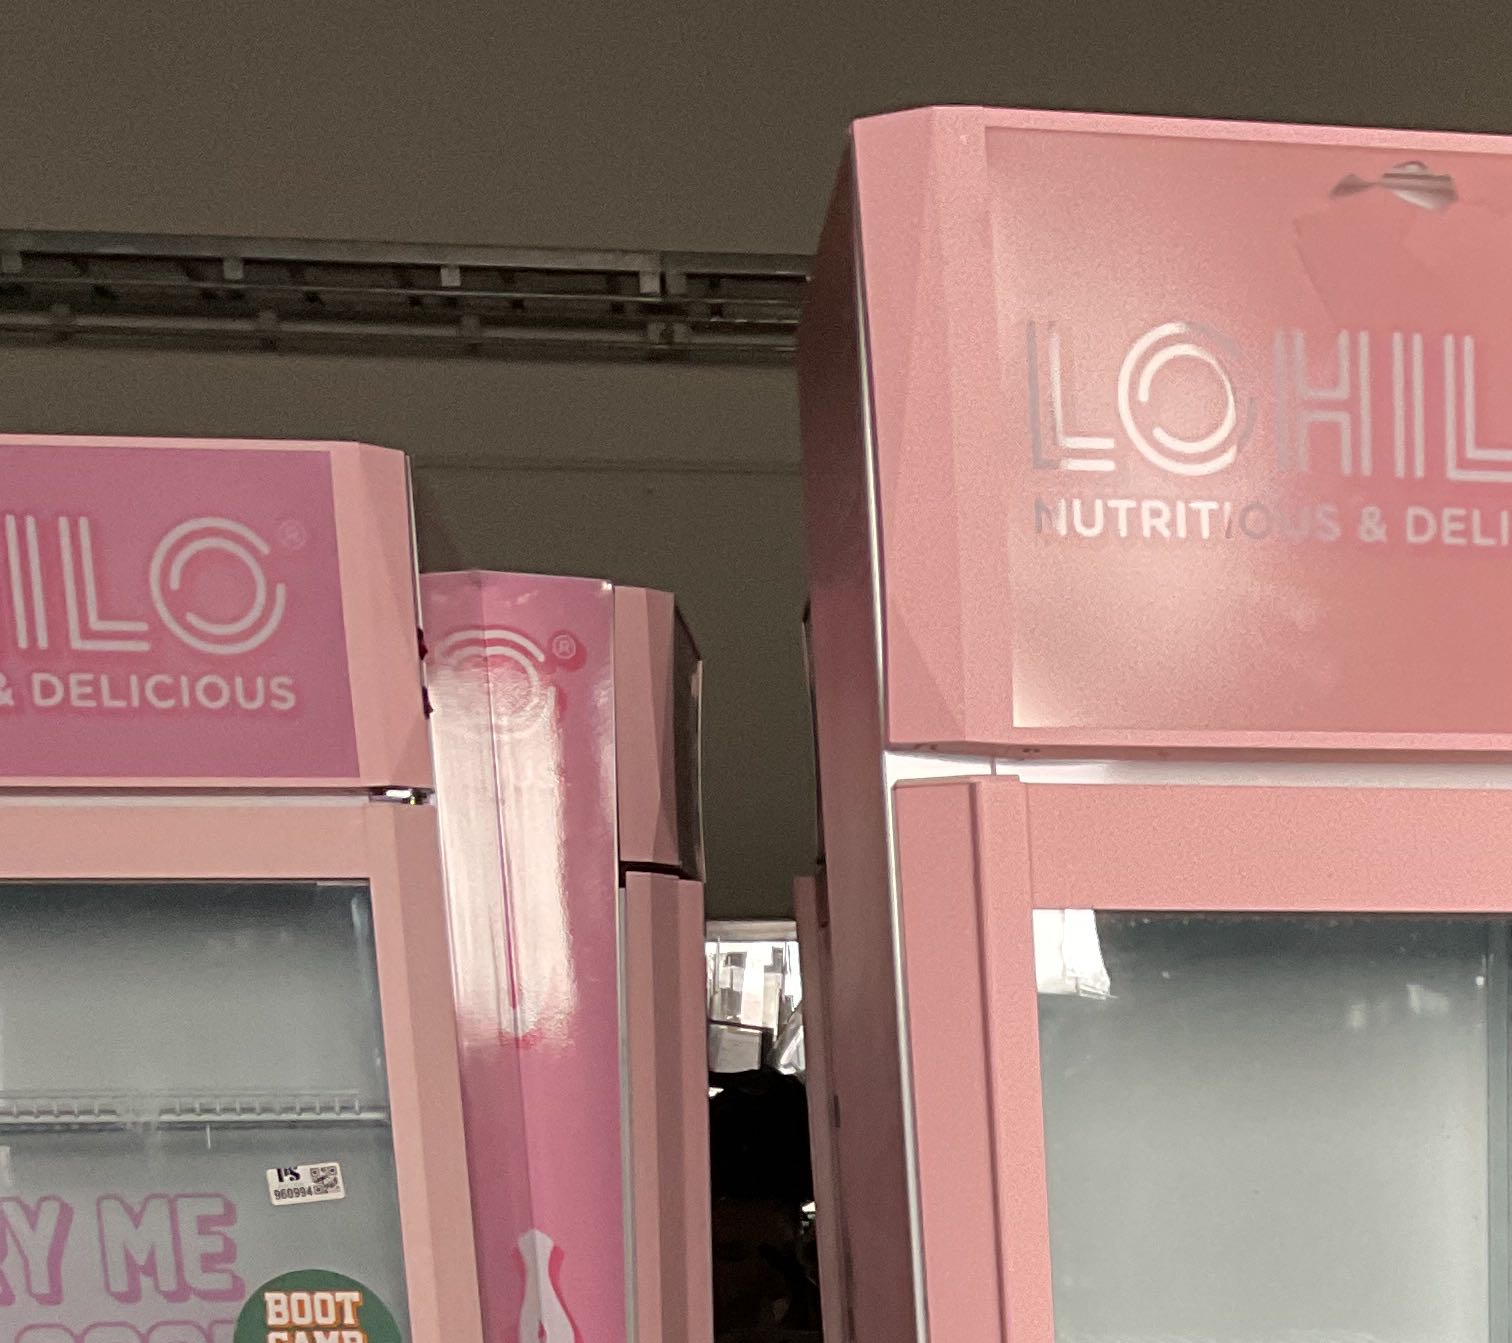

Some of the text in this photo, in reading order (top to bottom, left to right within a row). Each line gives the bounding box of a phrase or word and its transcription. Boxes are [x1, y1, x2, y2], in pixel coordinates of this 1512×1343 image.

[1034, 499, 1342, 542] NUTRITIOUS
[1358, 506, 1387, 543] &
[32, 672, 297, 710] DELICIOUS
[97, 1193, 246, 1303] ME
[264, 1291, 362, 1327] BOOT
